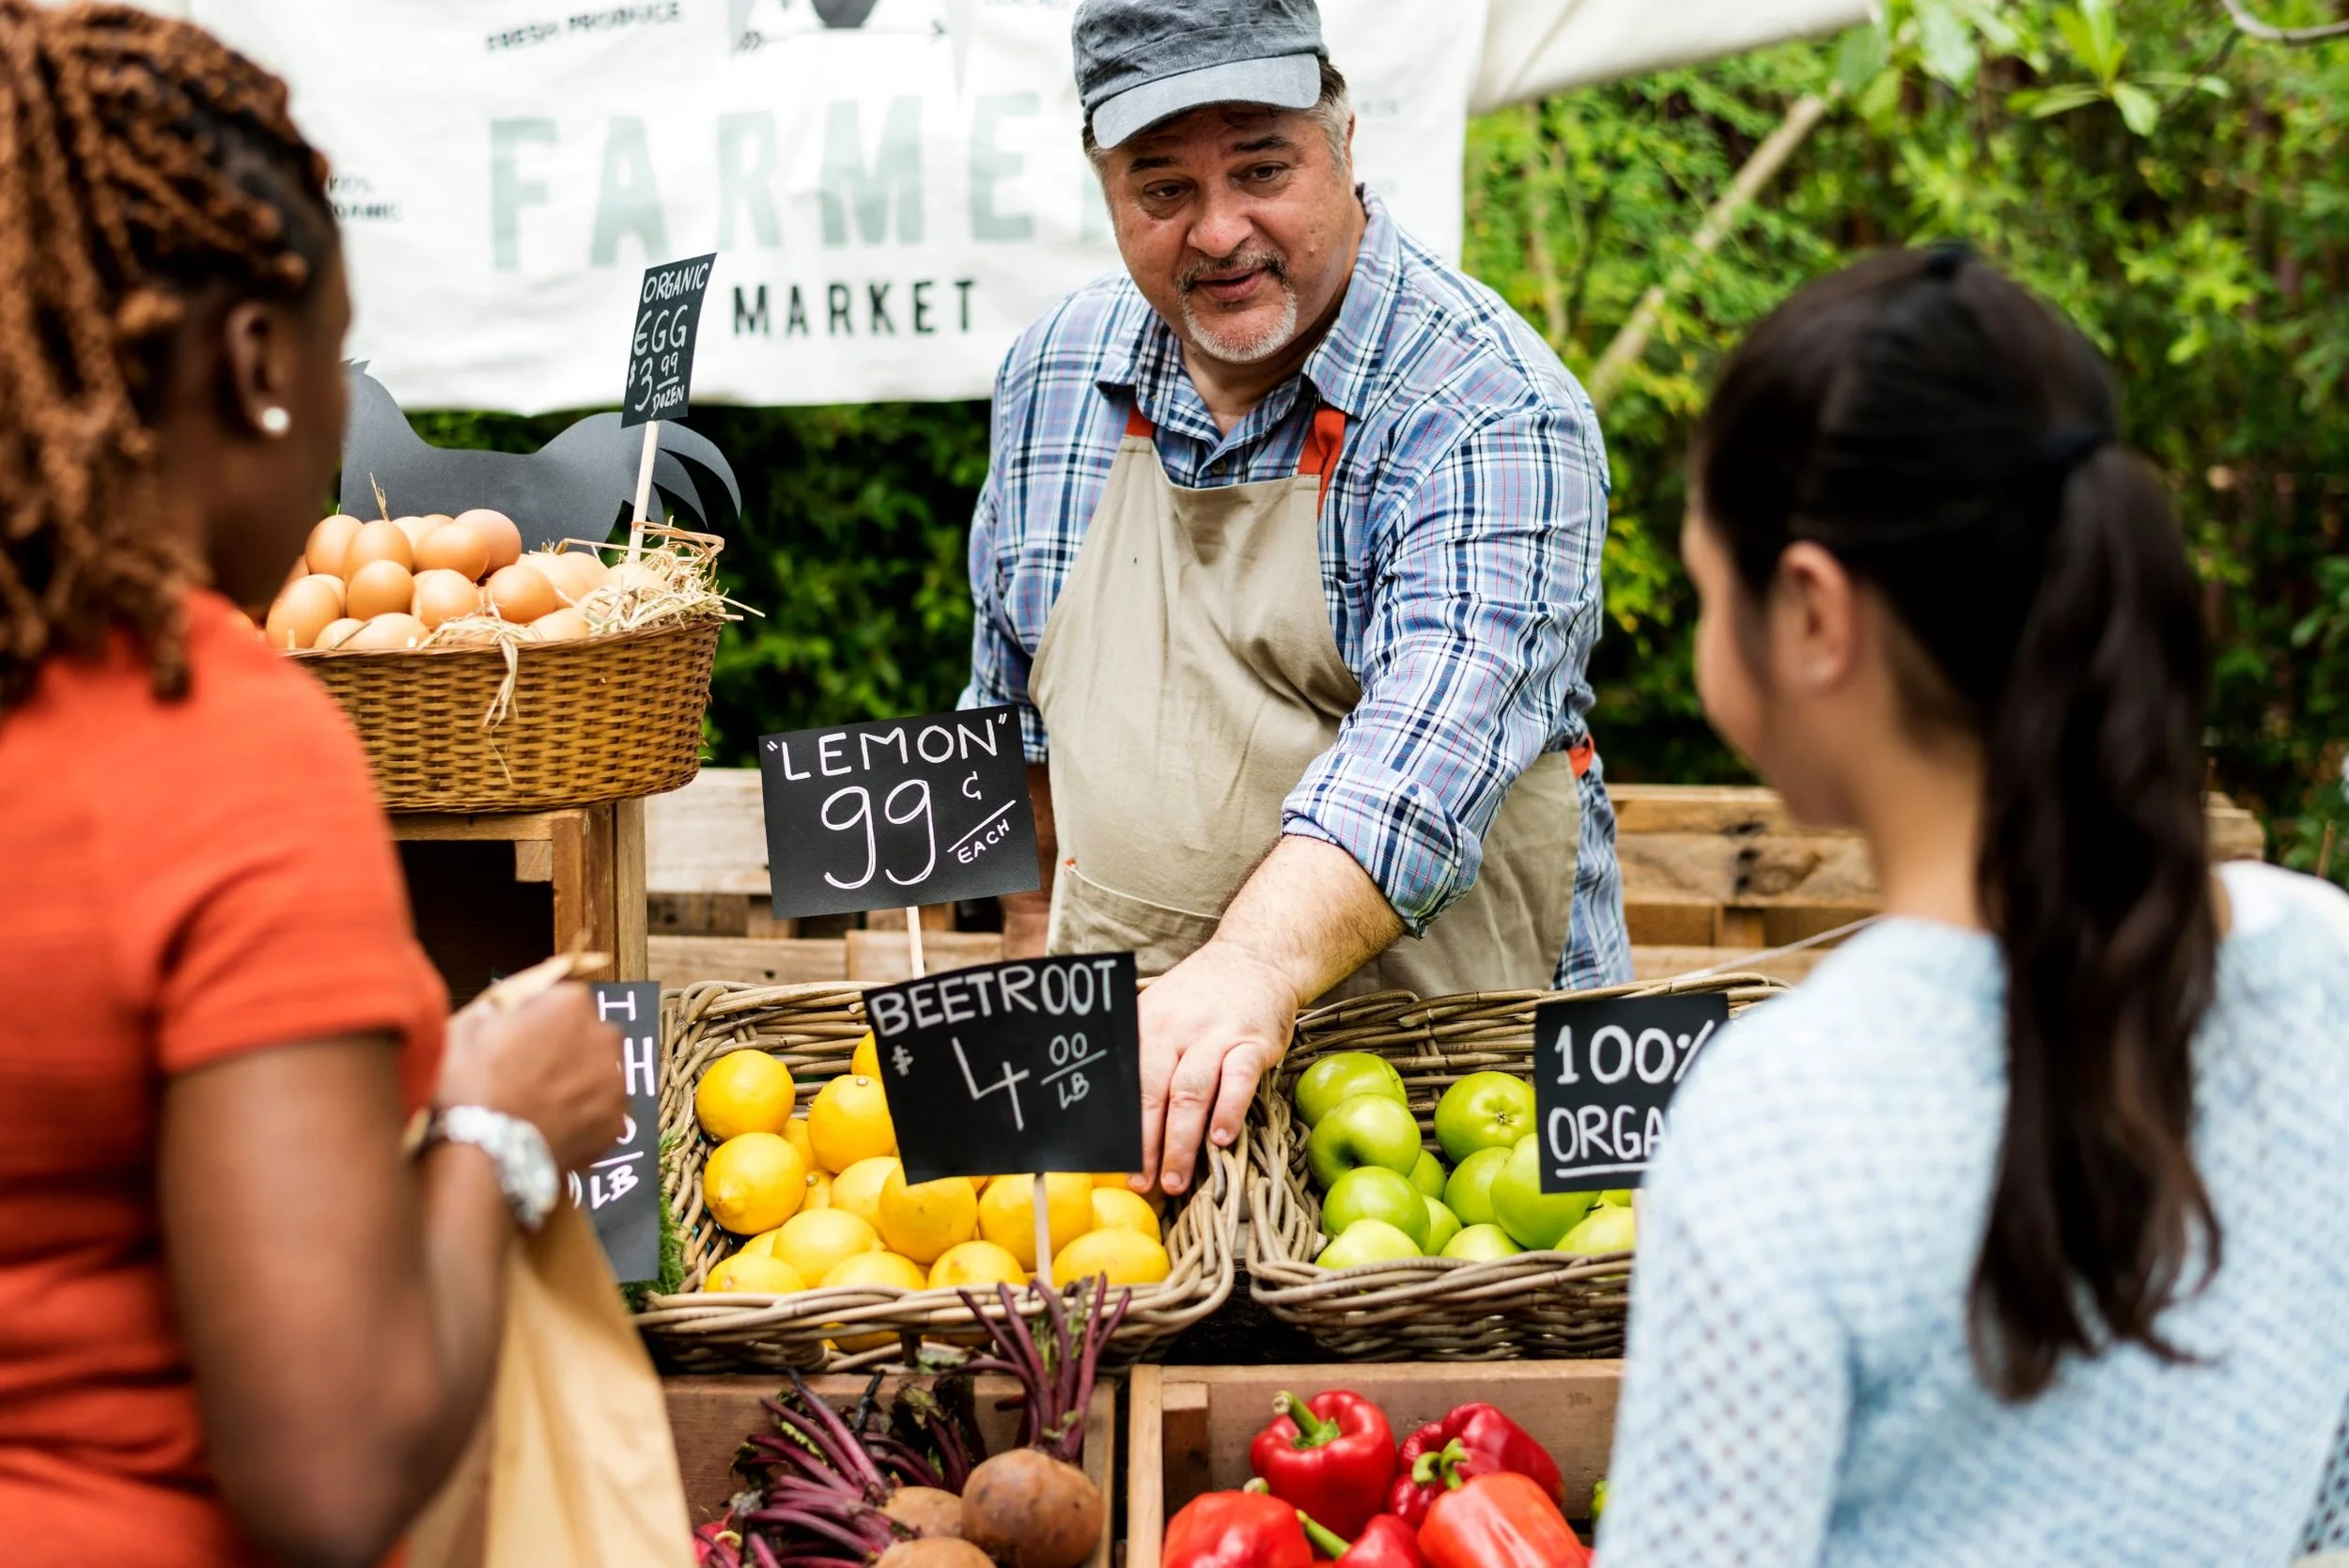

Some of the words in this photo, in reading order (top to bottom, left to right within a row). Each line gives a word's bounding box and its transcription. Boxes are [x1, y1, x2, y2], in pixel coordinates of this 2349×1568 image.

[643, 262, 708, 303] ORGANIC
[734, 279, 974, 335] MARKET
[633, 303, 689, 356] EGG
[651, 384, 685, 417] DOZEN
[957, 818, 1011, 864] EACH
[869, 959, 1117, 1037] BEETROOT
[1554, 1018, 1716, 1085] 100%
[1058, 1072, 1090, 1110] LB
[1548, 1104, 1668, 1163] ORGA
[589, 1164, 639, 1210] LB
